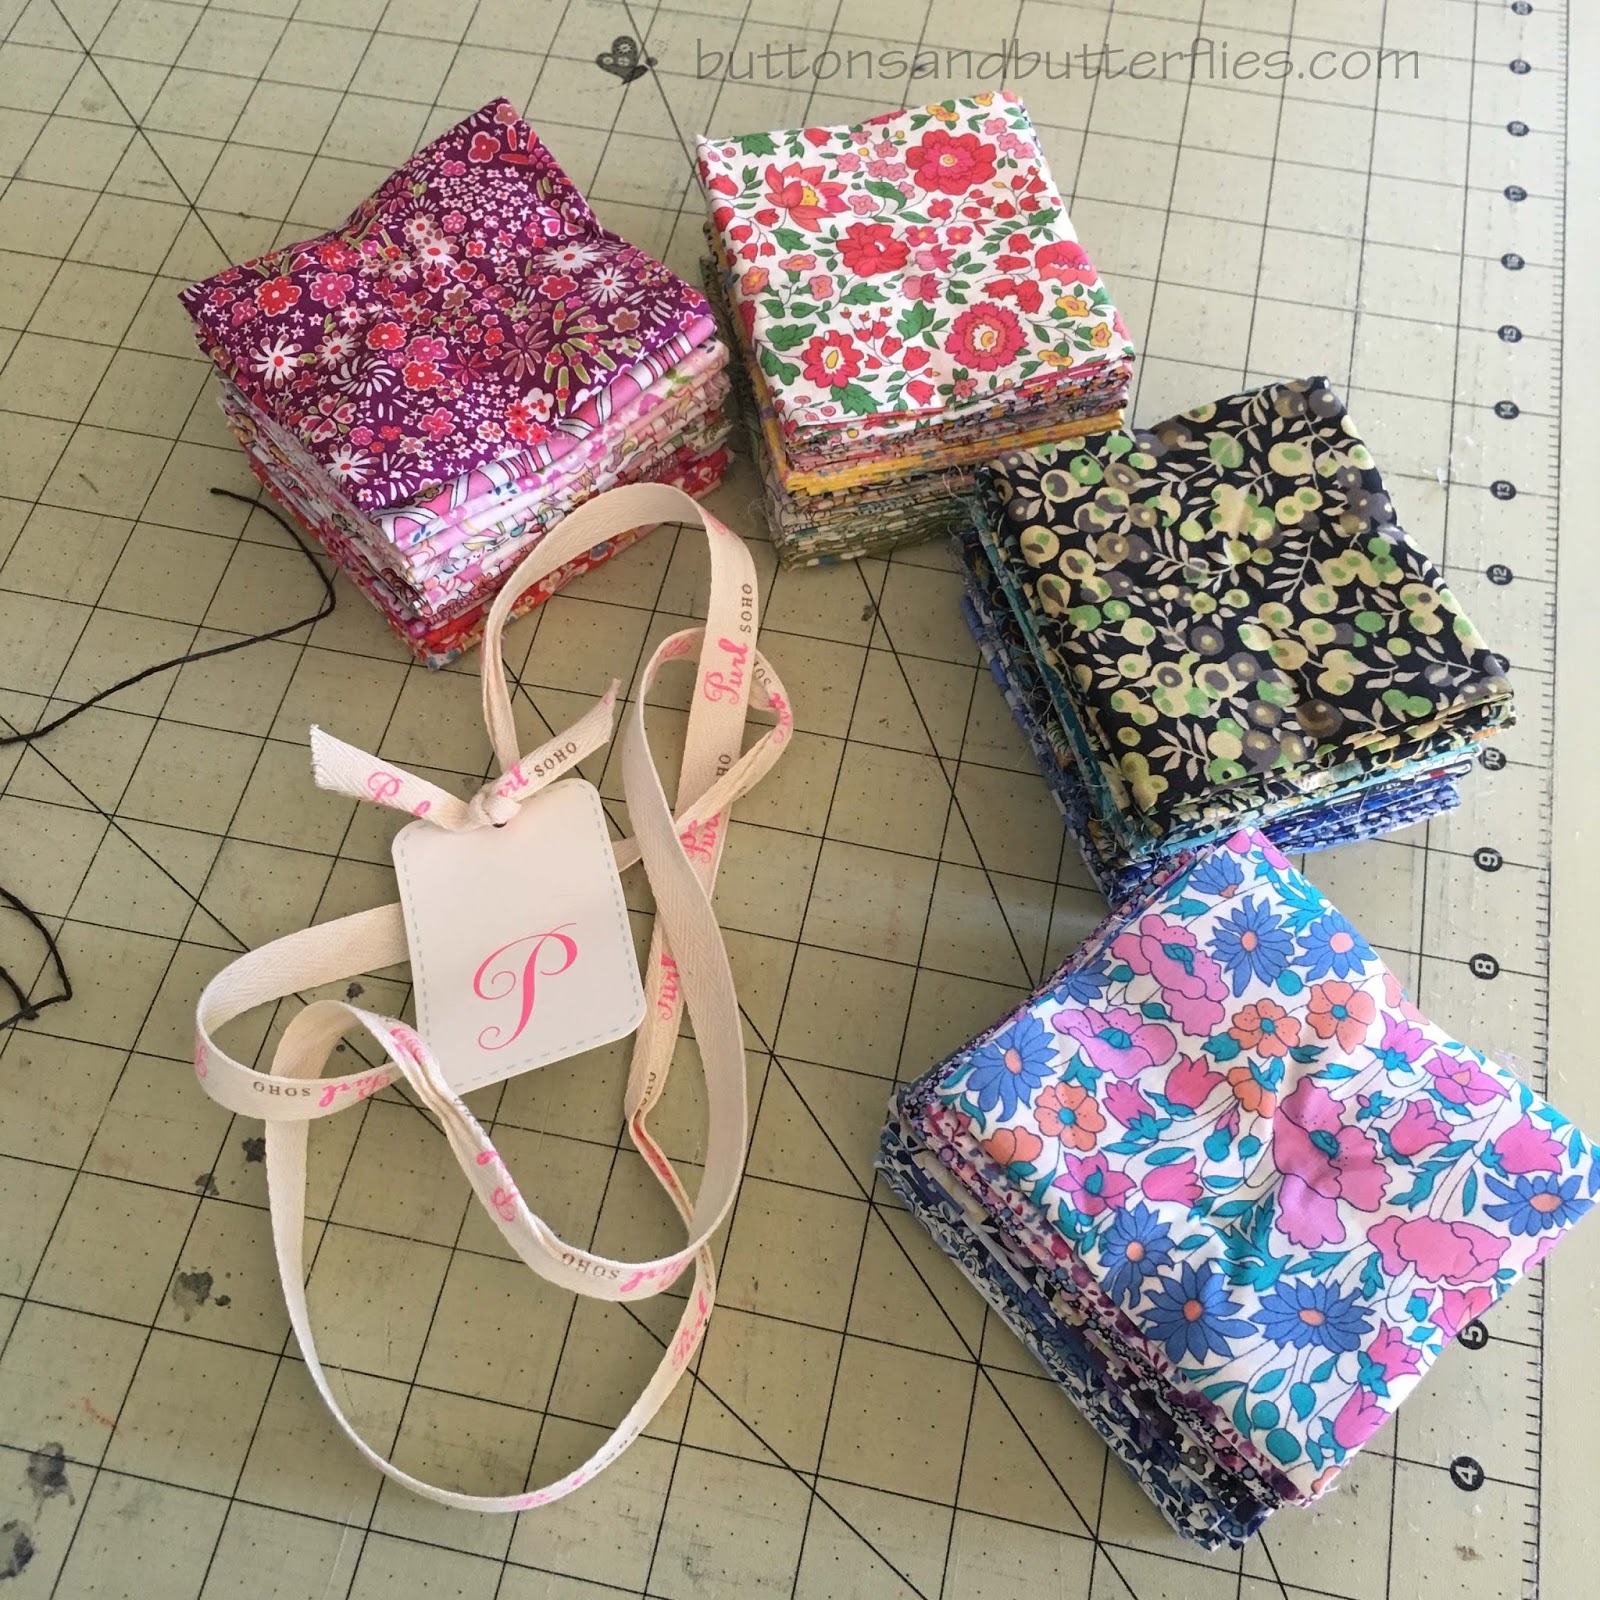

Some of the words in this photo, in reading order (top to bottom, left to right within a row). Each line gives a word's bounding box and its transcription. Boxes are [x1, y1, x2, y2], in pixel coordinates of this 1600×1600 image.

[1496, 483, 1511, 498] 13
[1493, 566, 1508, 583] 12
[703, 638, 748, 705] Purl
[740, 583, 753, 633] SOHO
[534, 741, 577, 777] SOHO
[1485, 749, 1502, 768] 10
[1478, 852, 1499, 868] 9
[1474, 958, 1496, 975] 8
[473, 922, 578, 1051] P
[252, 1080, 311, 1097] SOHO
[562, 1252, 621, 1281] SOHO
[1461, 1325, 1483, 1342] 5
[1457, 1463, 1479, 1485] 4
